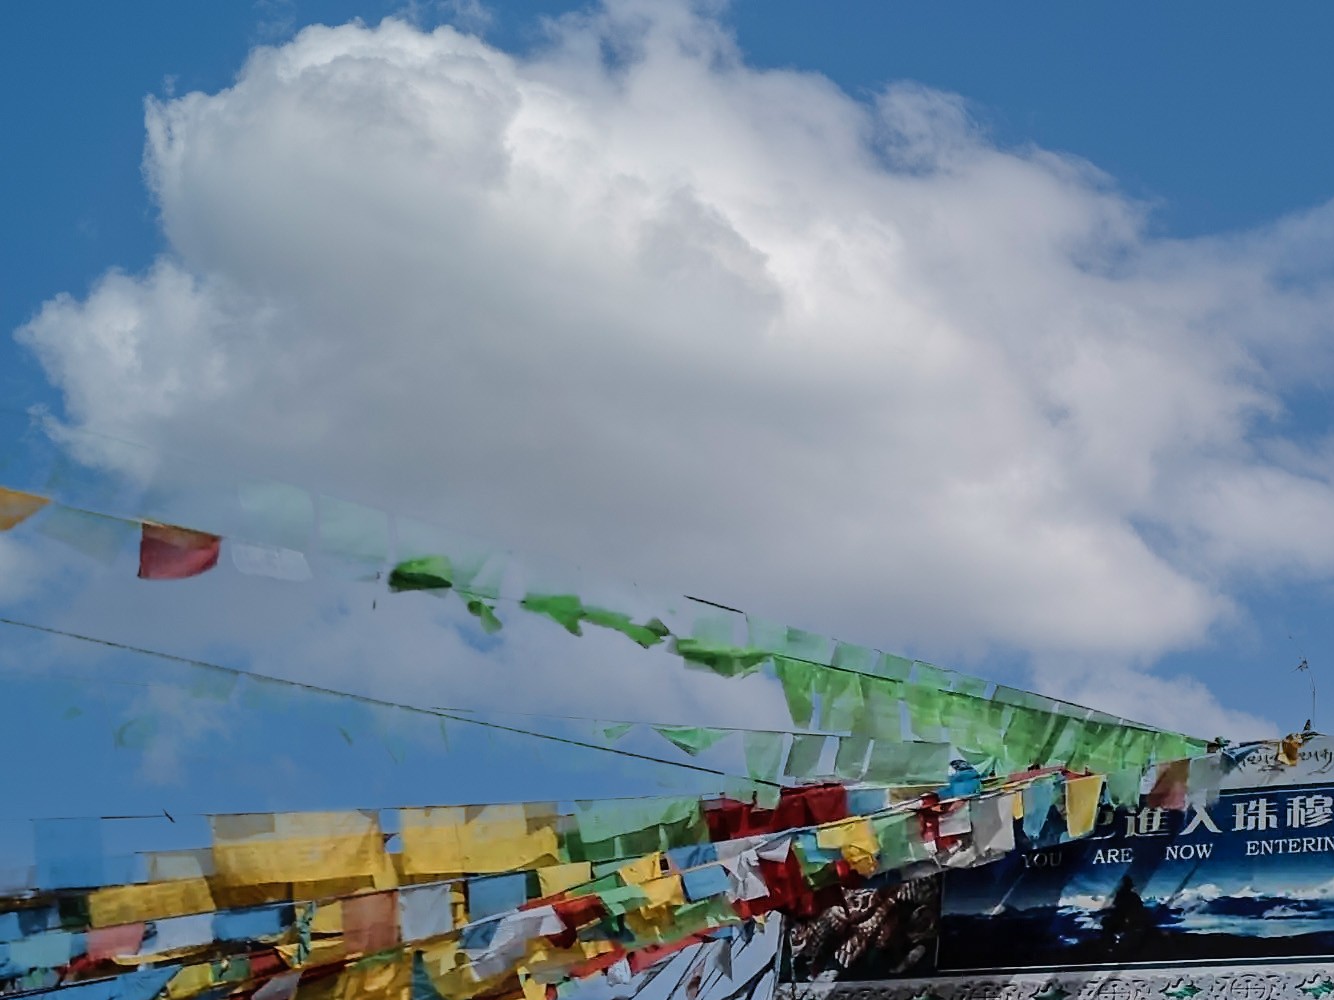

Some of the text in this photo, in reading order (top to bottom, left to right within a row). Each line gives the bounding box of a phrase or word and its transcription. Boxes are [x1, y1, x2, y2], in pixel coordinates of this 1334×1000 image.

[1022, 850, 1062, 868] YOU
[1092, 848, 1134, 865] ARE
[1165, 843, 1214, 861] NOW
